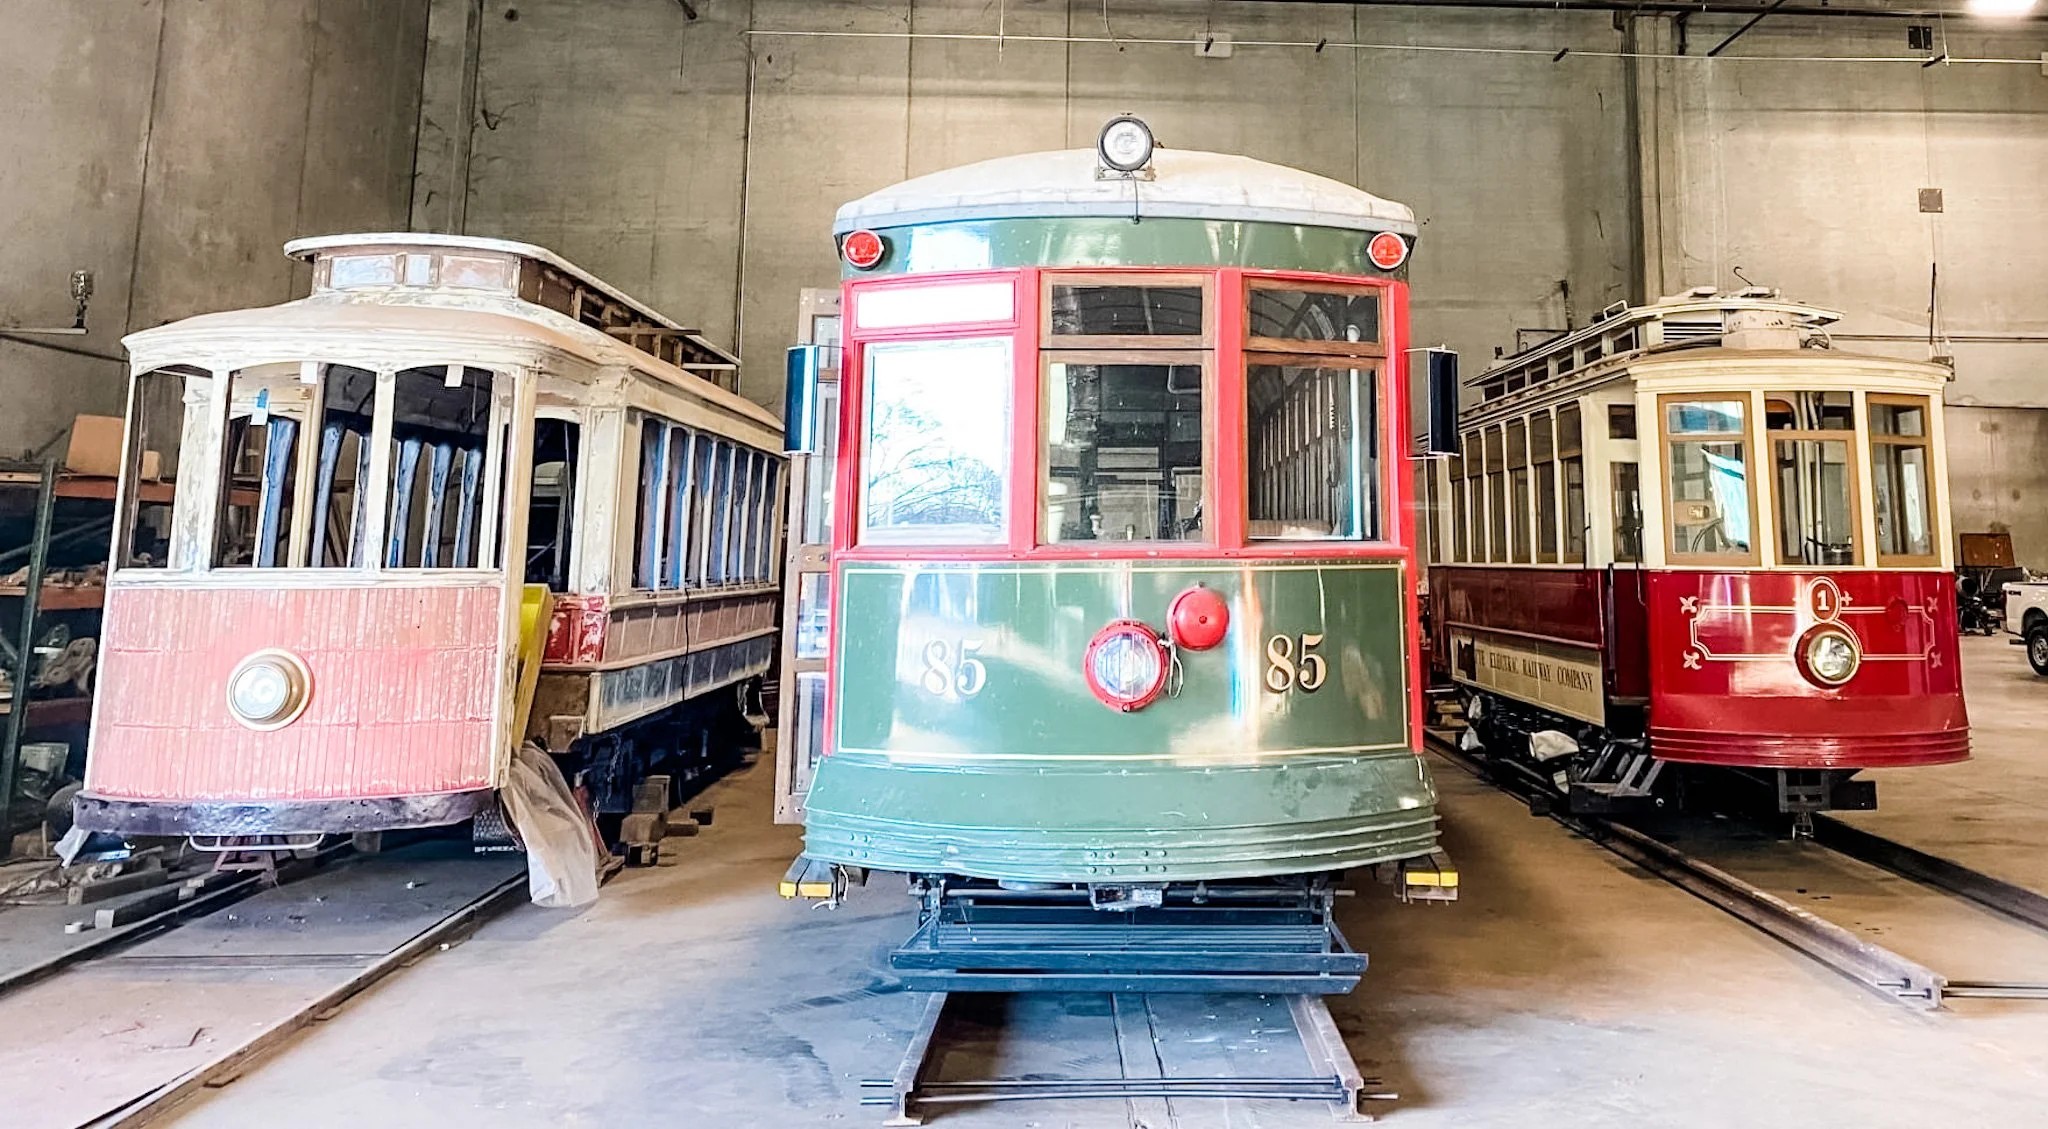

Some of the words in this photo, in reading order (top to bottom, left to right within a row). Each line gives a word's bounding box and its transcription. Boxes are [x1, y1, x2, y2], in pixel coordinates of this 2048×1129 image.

[1817, 590, 1830, 610] 1
[920, 638, 987, 695] 85
[1265, 633, 1326, 692] 85
[1557, 666, 1593, 692] COMPANY
